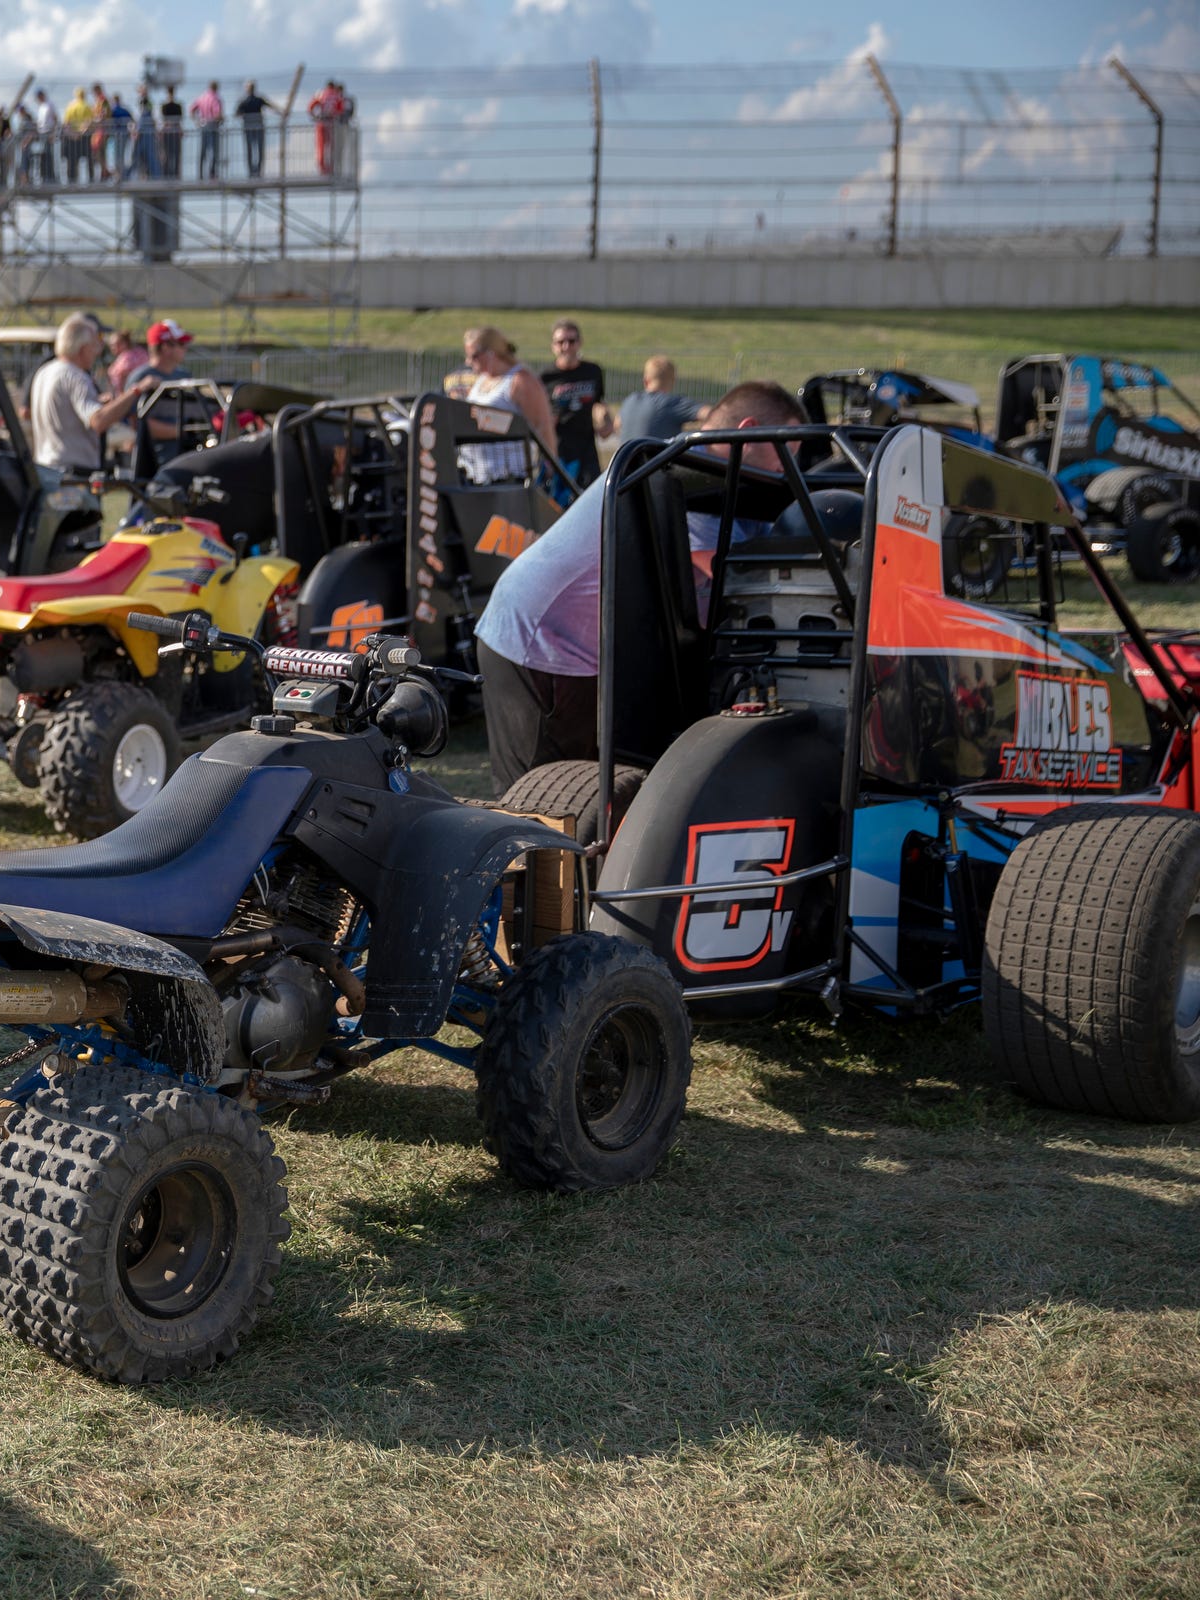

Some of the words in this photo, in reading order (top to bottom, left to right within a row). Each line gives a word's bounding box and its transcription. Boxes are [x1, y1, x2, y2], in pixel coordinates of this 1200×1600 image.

[1113, 427, 1200, 479] SiriusX
[266, 658, 348, 679] RENTHAL
[268, 645, 351, 666] RENTHAL
[1002, 749, 1034, 781] TAX
[1037, 750, 1121, 783] SERVICE
